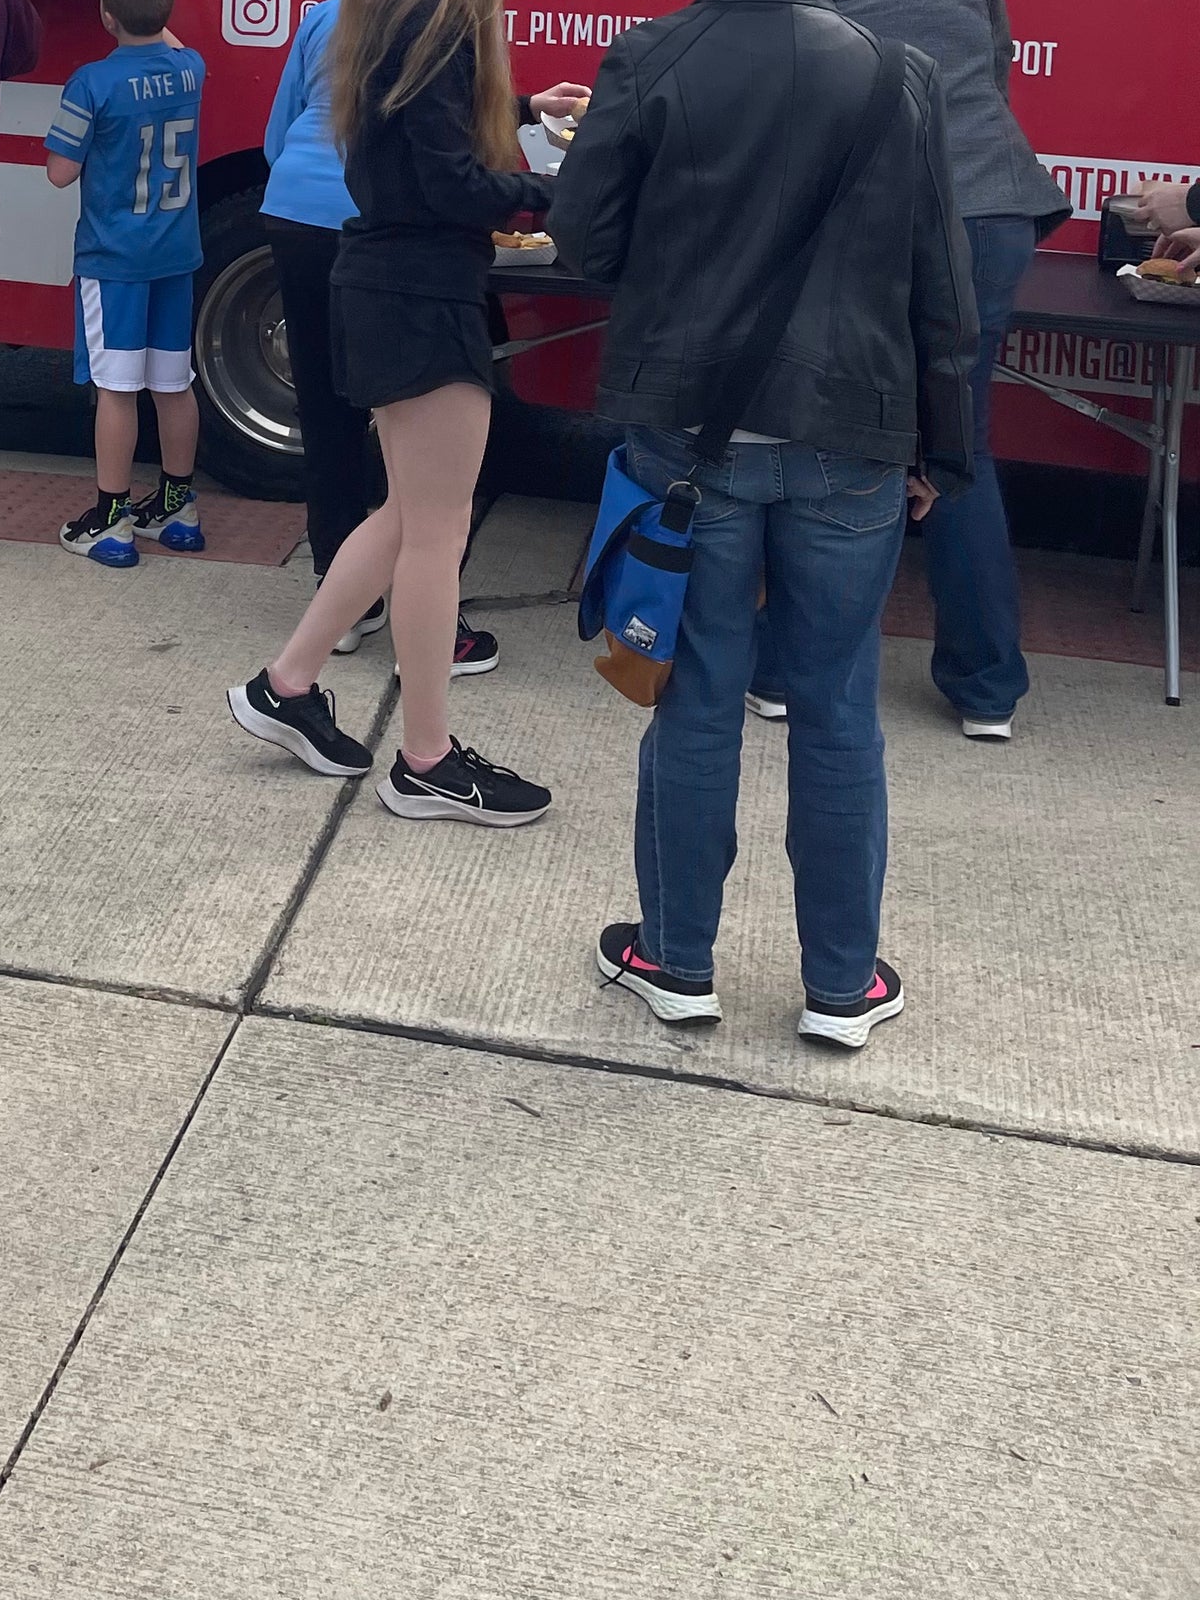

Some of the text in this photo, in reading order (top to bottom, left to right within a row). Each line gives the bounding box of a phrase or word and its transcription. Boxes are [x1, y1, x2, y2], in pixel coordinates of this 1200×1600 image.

[504, 10, 654, 47] T_PLYMO
[128, 69, 196, 100] TATE III
[133, 117, 196, 215] 15
